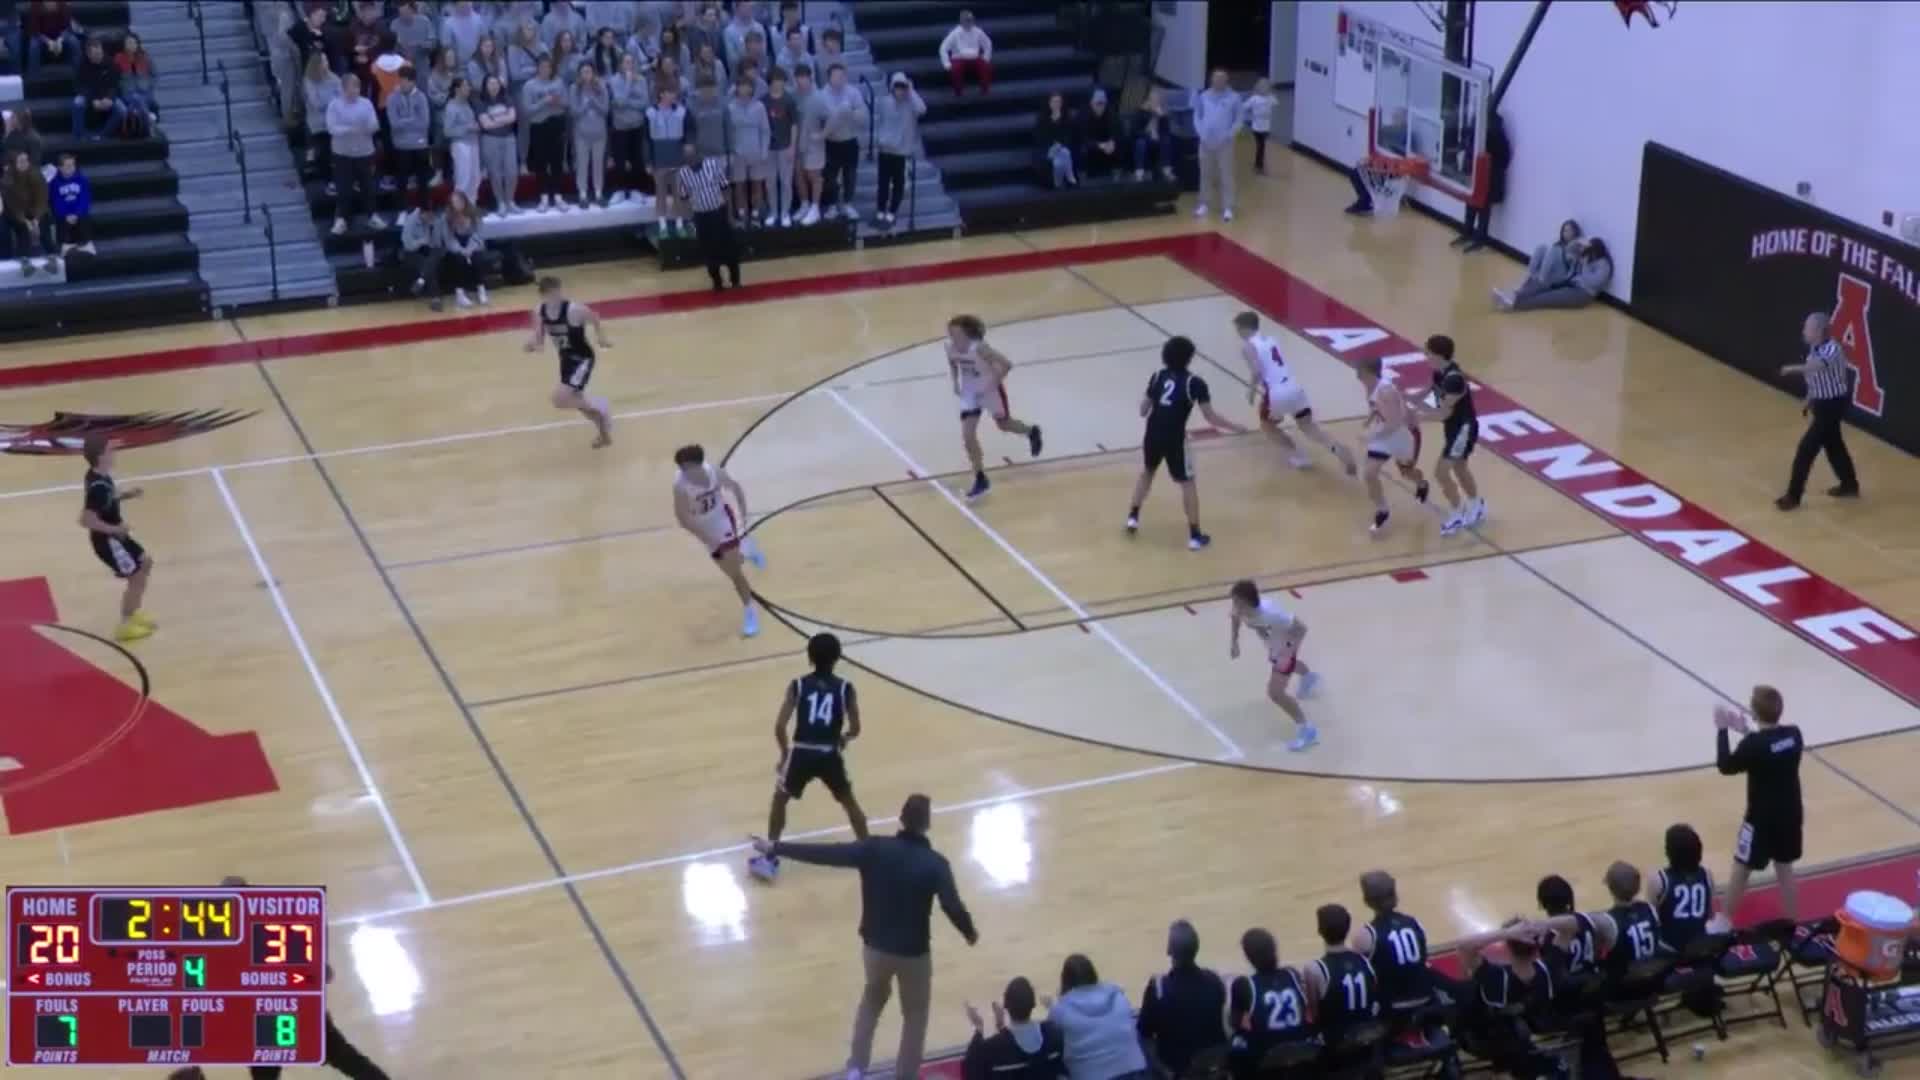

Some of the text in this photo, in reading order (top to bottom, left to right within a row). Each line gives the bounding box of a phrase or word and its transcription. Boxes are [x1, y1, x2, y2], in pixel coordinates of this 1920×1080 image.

[1751, 227, 1809, 258] HOME
[1811, 229, 1841, 258] OF
[1841, 236, 1879, 274] THE
[1160, 380, 1177, 407] 2
[806, 690, 835, 727] 14
[1673, 883, 1706, 919] 20
[1387, 927, 1421, 966] 10
[1626, 920, 1655, 960] 15
[1263, 987, 1301, 1030] 23
[1342, 972, 1369, 1011] 11
